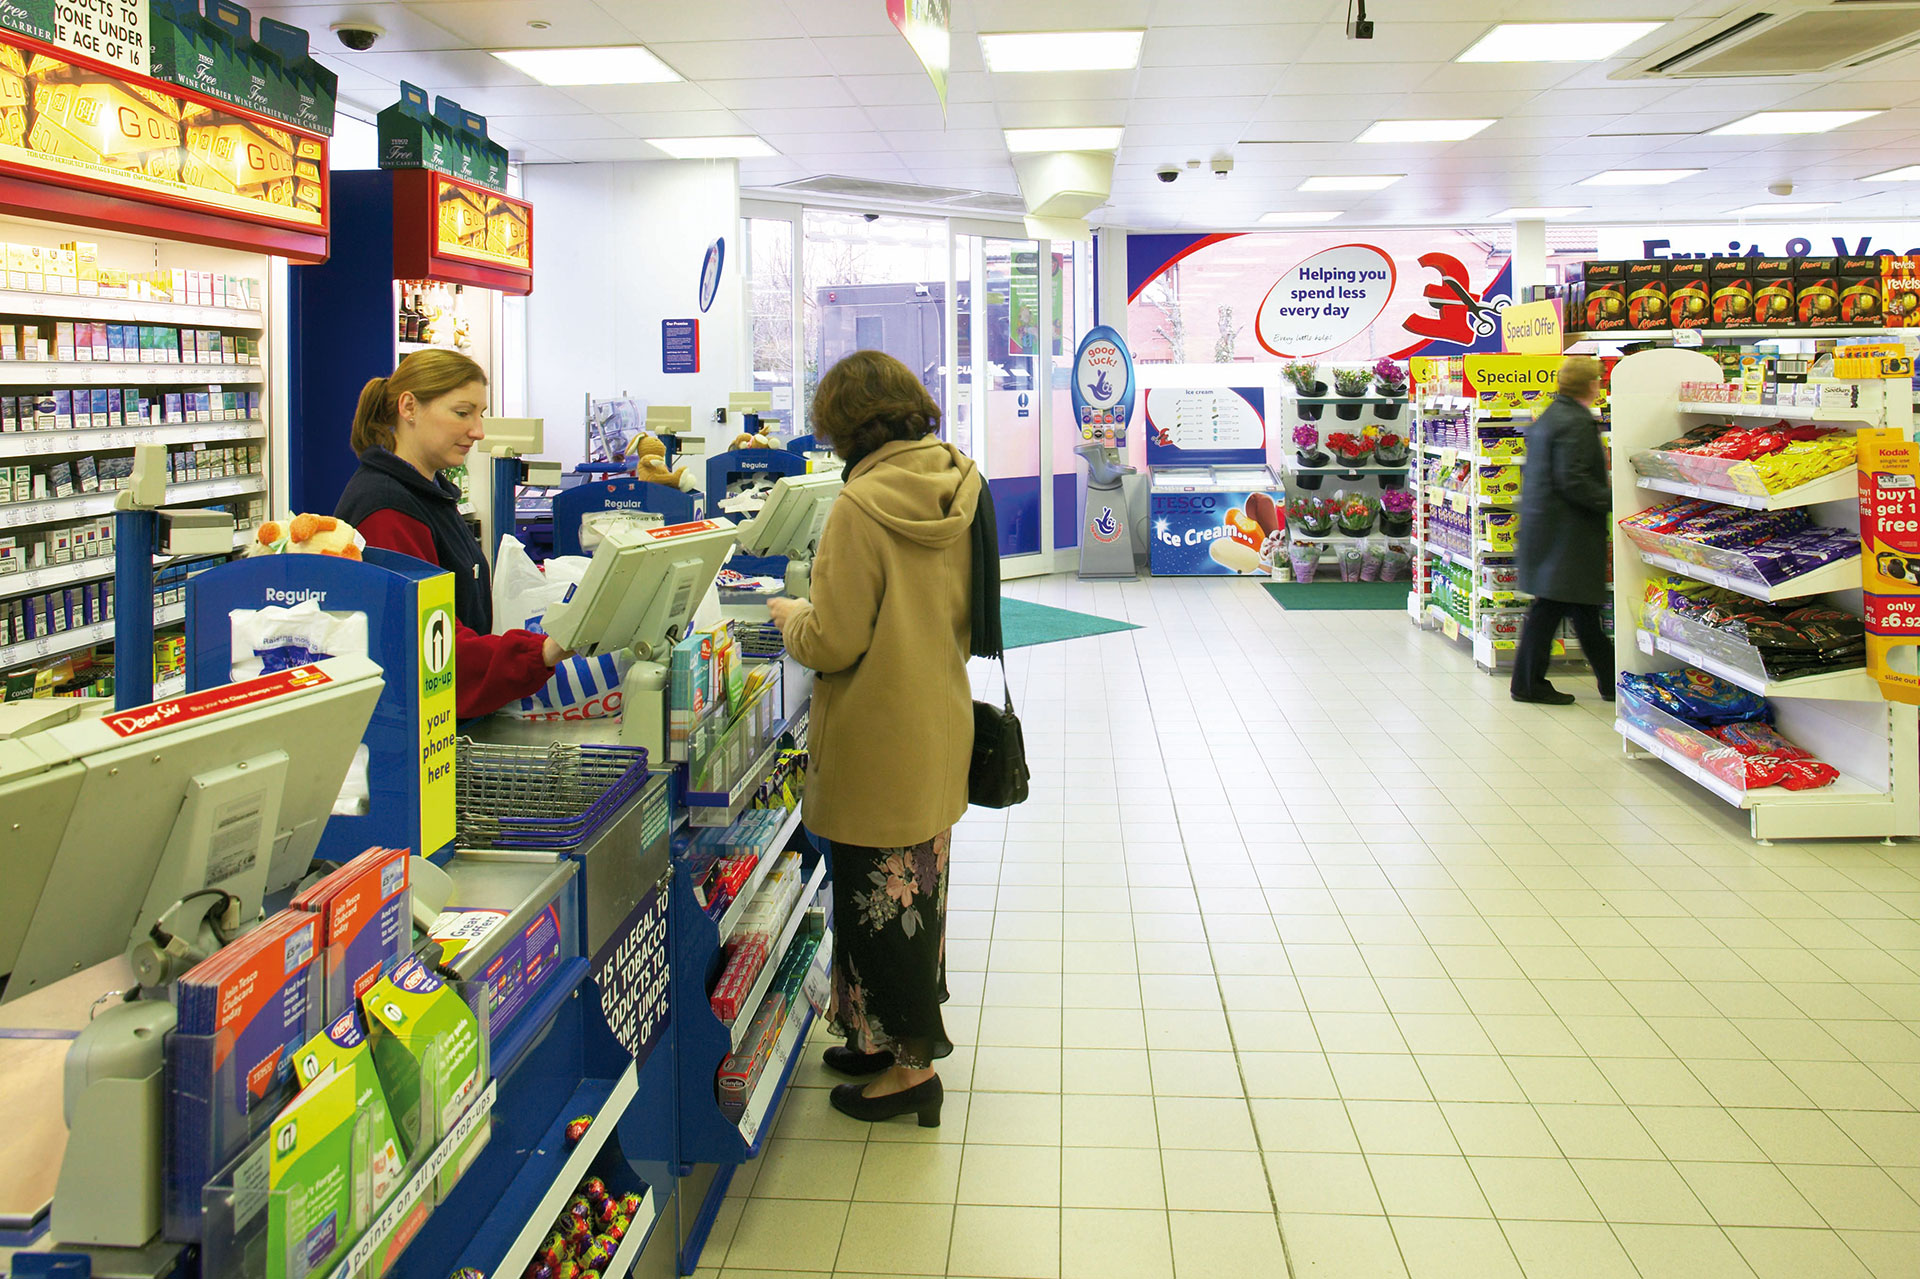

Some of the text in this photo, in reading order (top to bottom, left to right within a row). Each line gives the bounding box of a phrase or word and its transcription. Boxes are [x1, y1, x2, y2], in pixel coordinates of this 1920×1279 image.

[3, 15, 51, 40] CARRIER
[120, 8, 137, 26] TO
[99, 19, 143, 48] UNDER
[73, 31, 100, 53] AGE
[106, 43, 123, 60] OF
[130, 51, 140, 65] 16
[194, 63, 218, 86] Free
[178, 73, 231, 101] WINE CARRIER
[248, 84, 268, 105] Free
[234, 94, 281, 119] WINE CARRIER
[296, 102, 318, 122] Free
[118, 106, 178, 141] GOLD
[283, 113, 332, 135] WINE CARRIER
[247, 143, 292, 171] GOLD
[386, 145, 413, 160] Free
[1299, 267, 1386, 283] Helping you
[1891, 260, 1915, 269] revels
[1291, 286, 1366, 302] spend less
[1887, 278, 1920, 290] revels
[1280, 303, 1350, 319] every day
[1507, 317, 1555, 342] Special Offer
[1088, 347, 1116, 358] good
[1088, 358, 1118, 368] luck!
[1477, 369, 1558, 385] Special Of
[742, 462, 768, 470] Regular
[605, 499, 641, 509] Regular
[1152, 496, 1216, 510] TESCO
[1876, 489, 1915, 502] buy 1
[1860, 506, 1872, 517] free
[1876, 503, 1916, 516] get 1
[1877, 517, 1918, 532] free
[1157, 525, 1181, 547] Ice
[266, 588, 327, 604] Regular
[1887, 602, 1916, 613] only
[1496, 624, 1517, 633] Coke
[1881, 613, 1920, 627] £6.92
[425, 670, 452, 692] top-up
[1885, 674, 1902, 682] slide
[11, 687, 33, 698] CONDOR
[113, 711, 160, 734] Dear
[157, 703, 181, 720] Sir
[229, 694, 248, 703] Class
[247, 688, 270, 699] stamps
[427, 709, 450, 734] your
[423, 733, 455, 763] phone
[428, 761, 450, 784] here
[334, 903, 357, 928] Clubcard
[335, 893, 360, 918] Join Tesco
[334, 921, 349, 939] today
[450, 917, 482, 938] Great
[471, 915, 499, 938] offers
[603, 890, 668, 988] IS ILLEGAL TO
[621, 918, 666, 989] TOBACCO
[652, 946, 664, 975] TO
[224, 970, 258, 1003] Join Tesco
[638, 964, 670, 1022] UNDER
[223, 982, 254, 1014] Clubcard
[222, 1005, 242, 1026] today
[333, 1011, 355, 1037] new!
[641, 1012, 653, 1045] OF
[656, 993, 669, 1022] 16.
[253, 1060, 273, 1085] TESCO
[353, 1211, 393, 1272] points
[396, 1191, 411, 1214] on
[415, 1165, 428, 1193] all
[430, 1137, 453, 1178] your
[456, 1093, 490, 1141] top-ups
